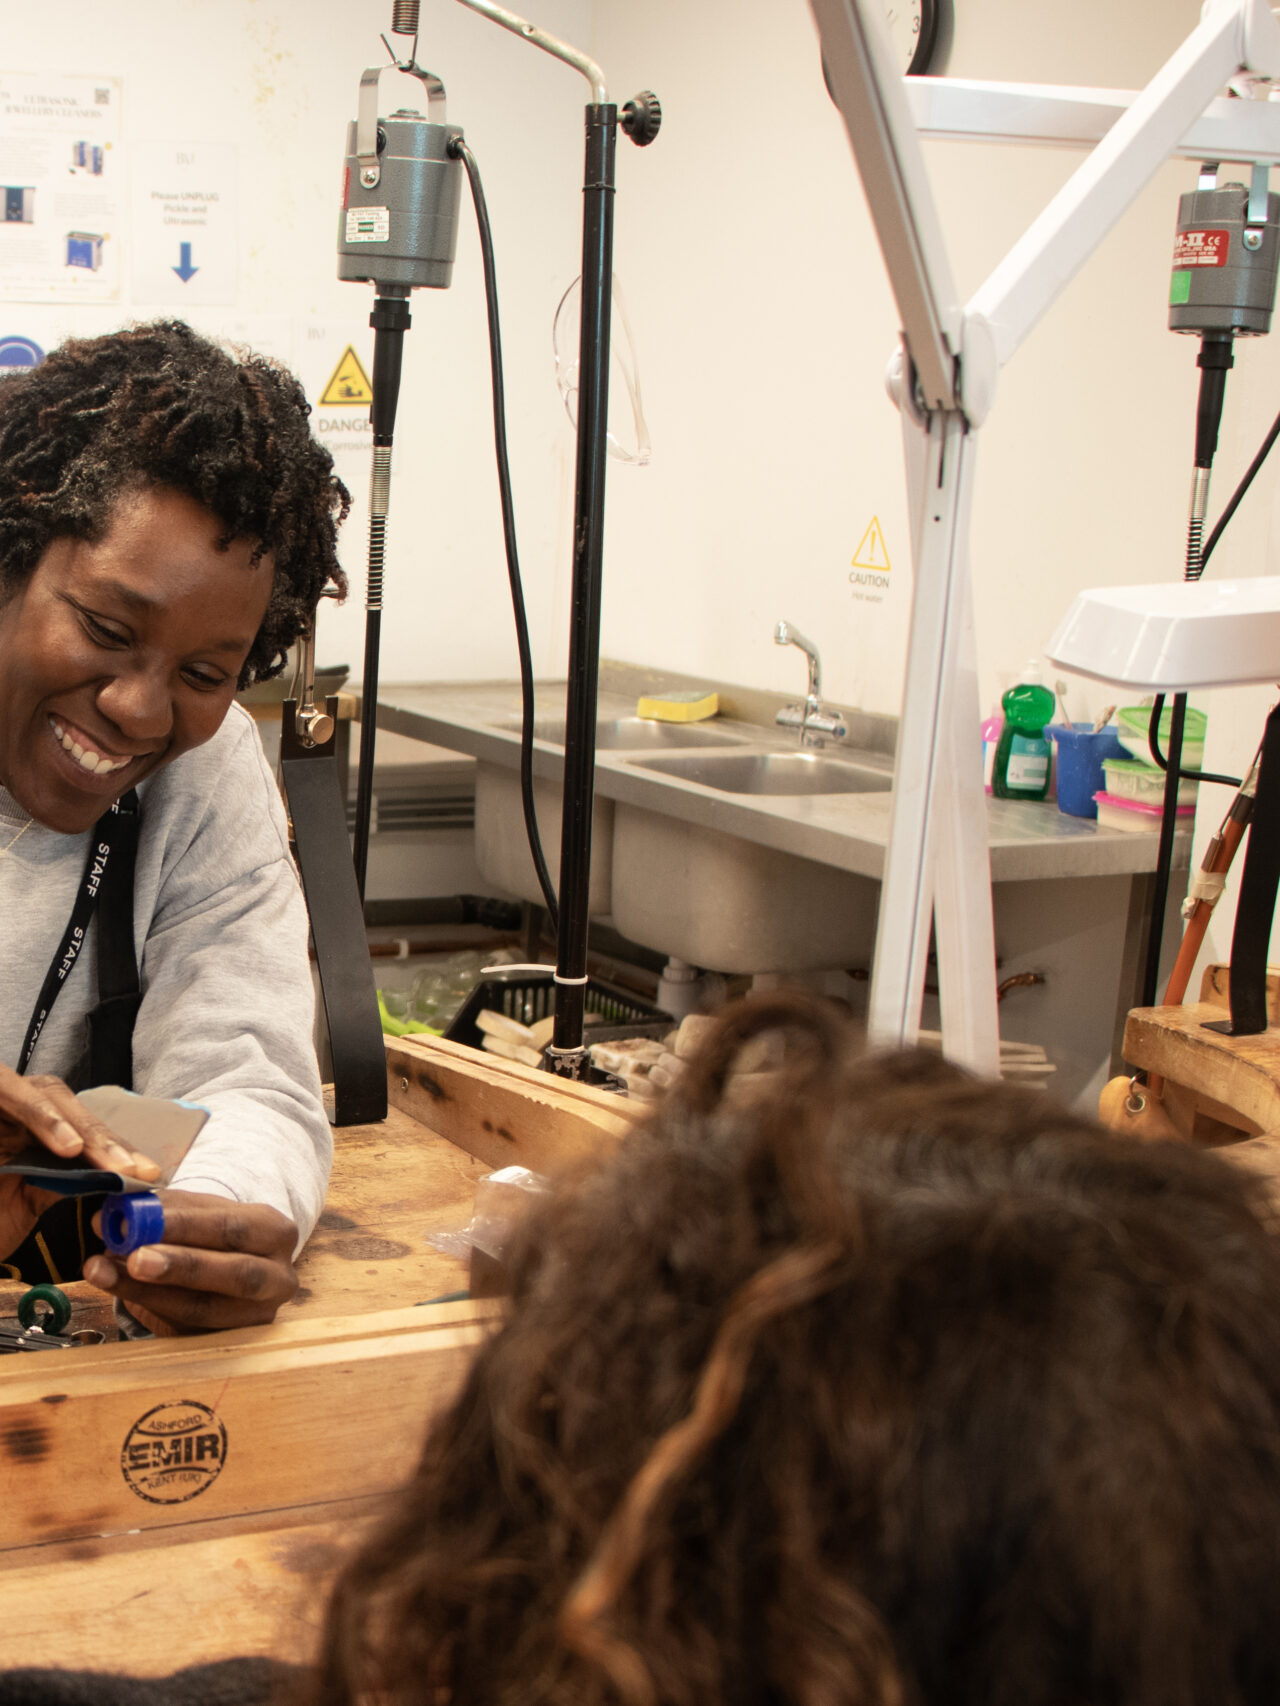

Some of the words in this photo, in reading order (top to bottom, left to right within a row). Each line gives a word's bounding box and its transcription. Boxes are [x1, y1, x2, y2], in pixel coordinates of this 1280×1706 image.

[151, 191, 178, 200] Please
[181, 191, 219, 202] UNPLUG
[192, 205, 207, 213] and
[318, 418, 371, 433] DANGE
[848, 572, 890, 588] CAUTION
[86, 842, 110, 898] STAFF
[57, 926, 84, 980] STAFF
[148, 1414, 201, 1431] ASHFORD
[128, 1433, 220, 1471] EMIR
[147, 1473, 175, 1490] KENT
